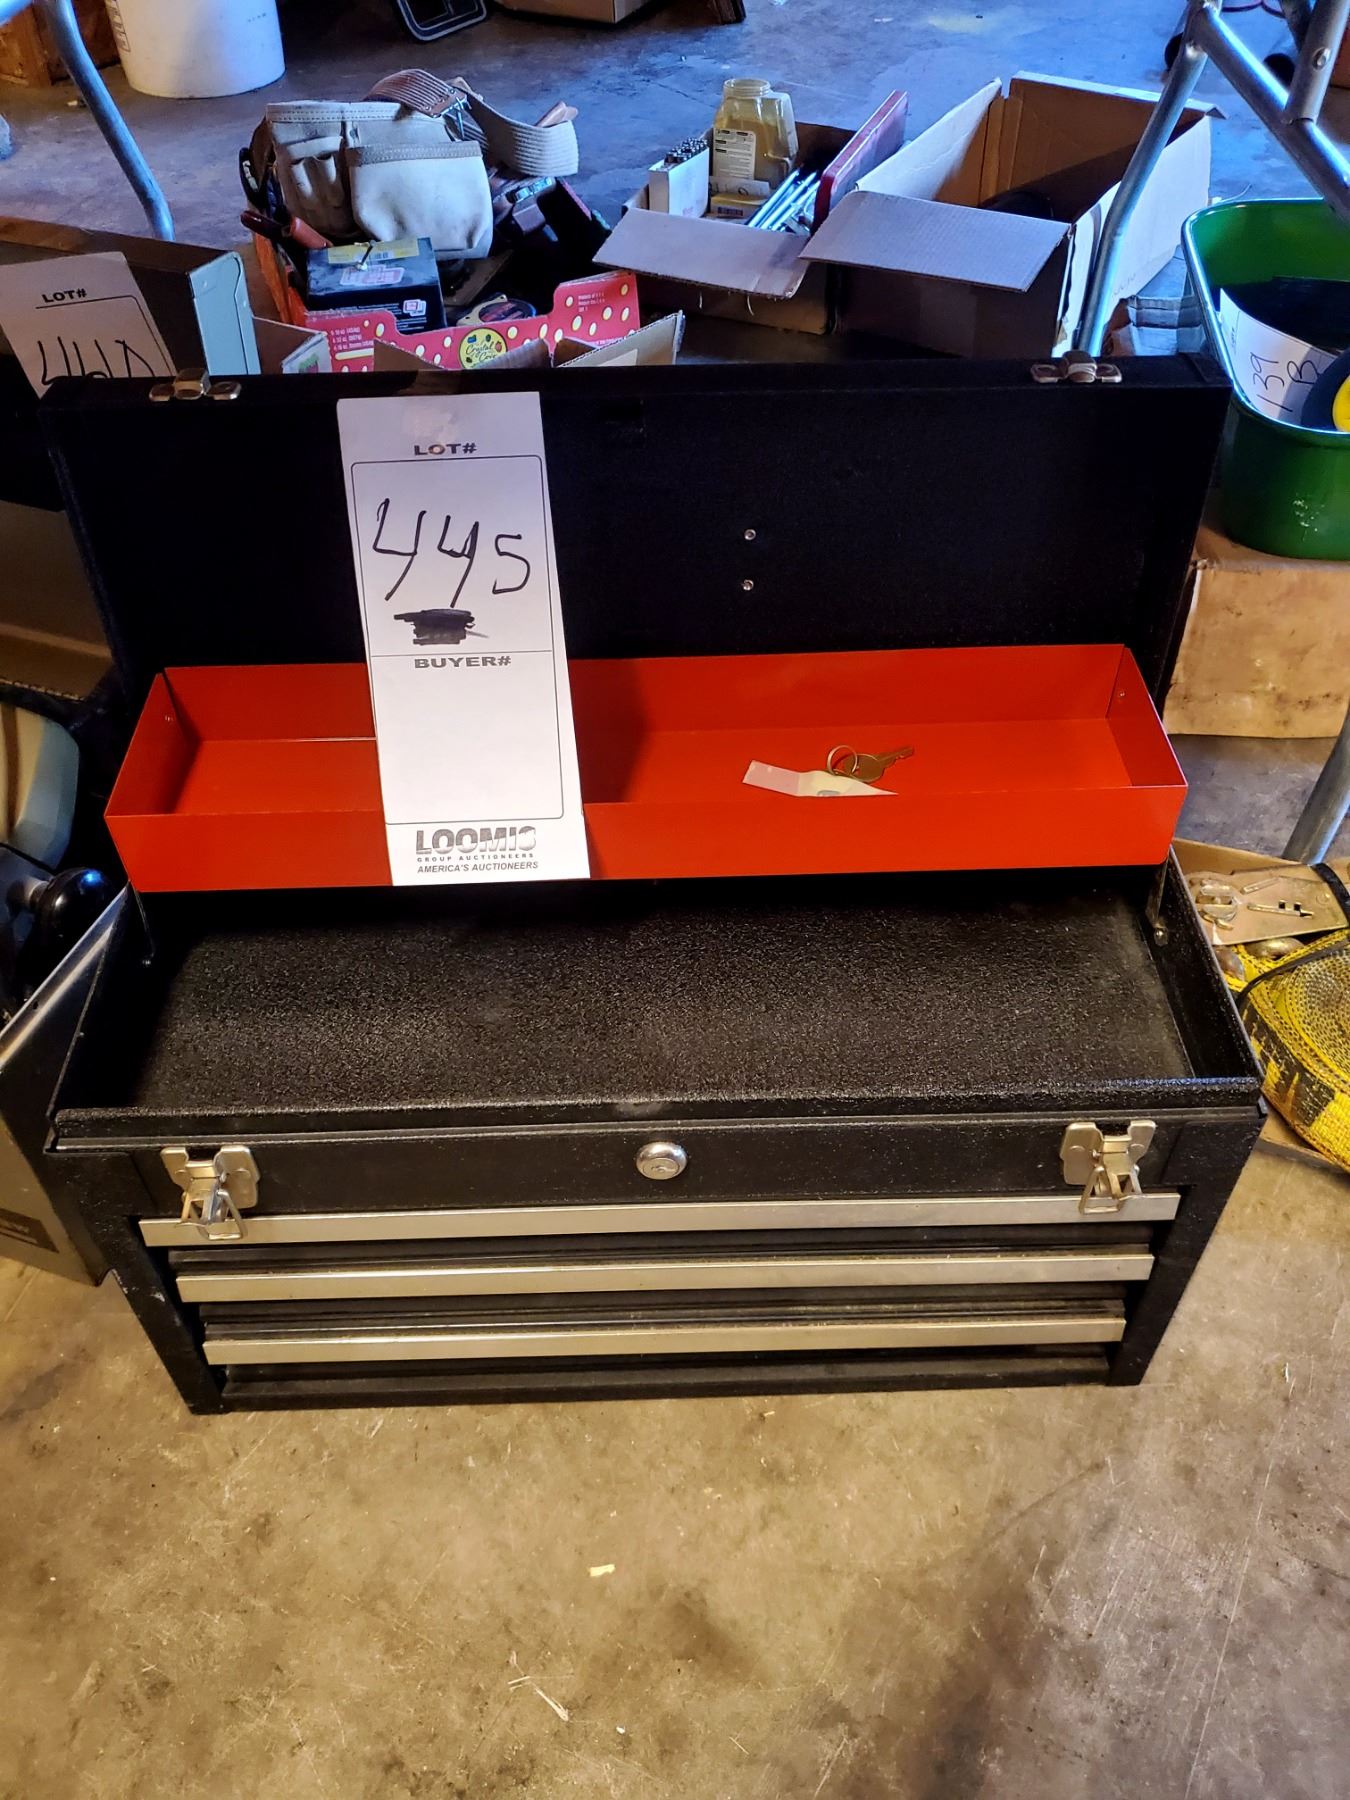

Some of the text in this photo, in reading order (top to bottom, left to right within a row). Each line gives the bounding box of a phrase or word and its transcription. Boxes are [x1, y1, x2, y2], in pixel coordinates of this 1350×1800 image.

[41, 287, 88, 303] LOT#
[1286, 359, 1322, 386] B
[1249, 351, 1294, 413] 139
[413, 442, 477, 456] LOT#
[372, 497, 531, 609] 445
[414, 655, 512, 669] BUYER#
[415, 825, 537, 855] LOOMIS
[416, 852, 535, 863] GROUP AUCTIONEERS
[416, 861, 539, 874] AMERICA'S AUCTIONEERS
